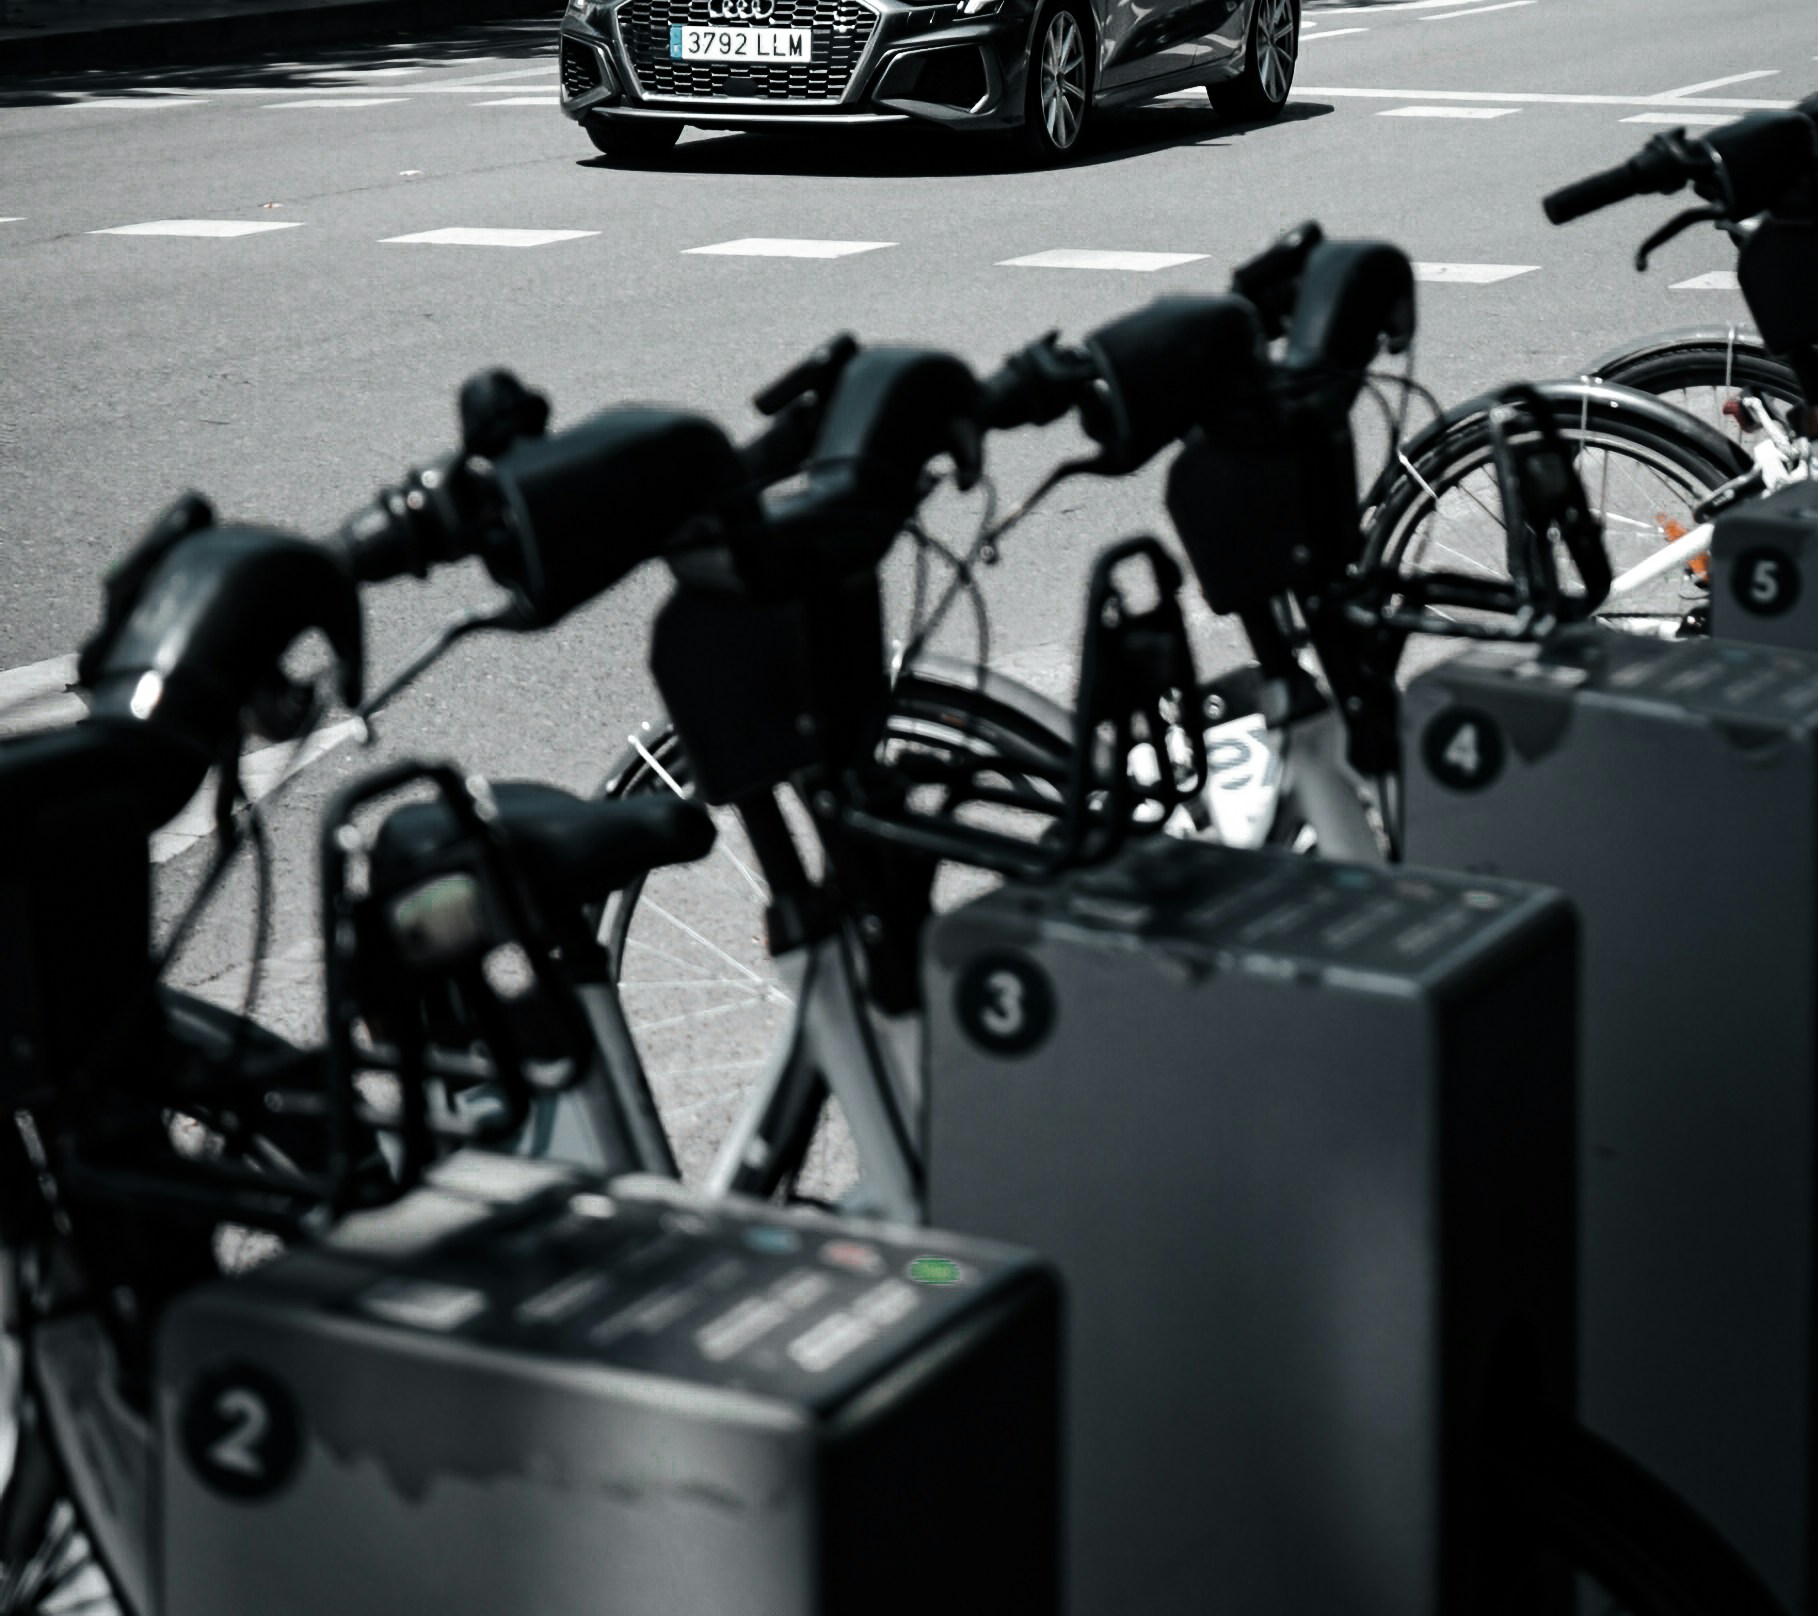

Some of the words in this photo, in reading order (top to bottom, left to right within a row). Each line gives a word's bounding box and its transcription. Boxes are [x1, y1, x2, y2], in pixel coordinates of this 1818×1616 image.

[688, 31, 748, 55] 3792
[757, 33, 803, 57] LLM
[1751, 559, 1779, 602] 5
[1444, 723, 1480, 774] 4
[982, 970, 1023, 1035] 3
[208, 1387, 269, 1476] 2
